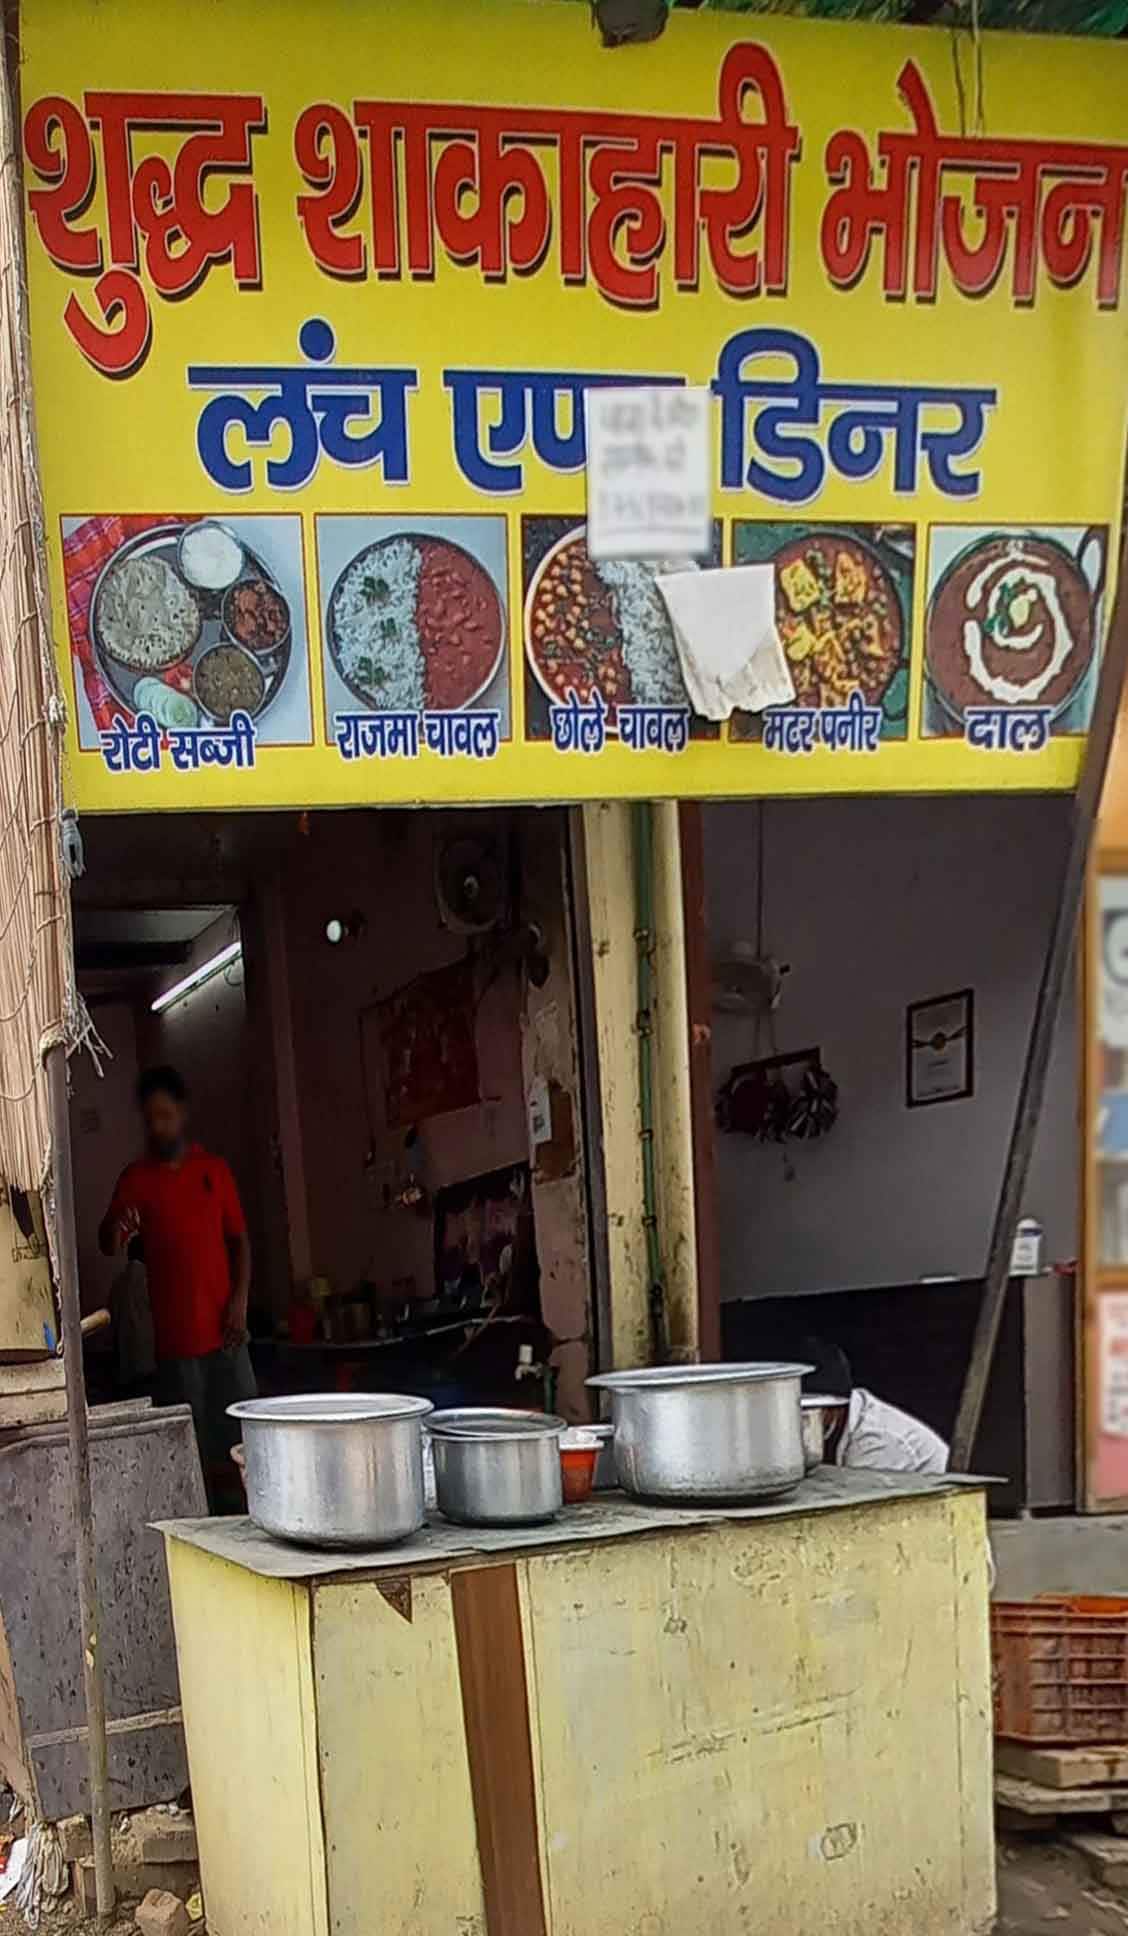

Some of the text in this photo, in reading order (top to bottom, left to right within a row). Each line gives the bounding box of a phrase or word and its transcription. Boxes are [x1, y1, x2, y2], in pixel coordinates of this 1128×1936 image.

[23, 41, 1128, 381] शुद्ध शाकाहारी भोजन
[187, 318, 419, 492] लंच
[711, 328, 998, 500] डिनर
[100, 710, 256, 772] रोटी सब्जी
[335, 711, 499, 760] राजमा चावल
[551, 690, 690, 753] छोले चावल
[819, 690, 882, 752] पनीर
[966, 708, 1051, 750] दाल
